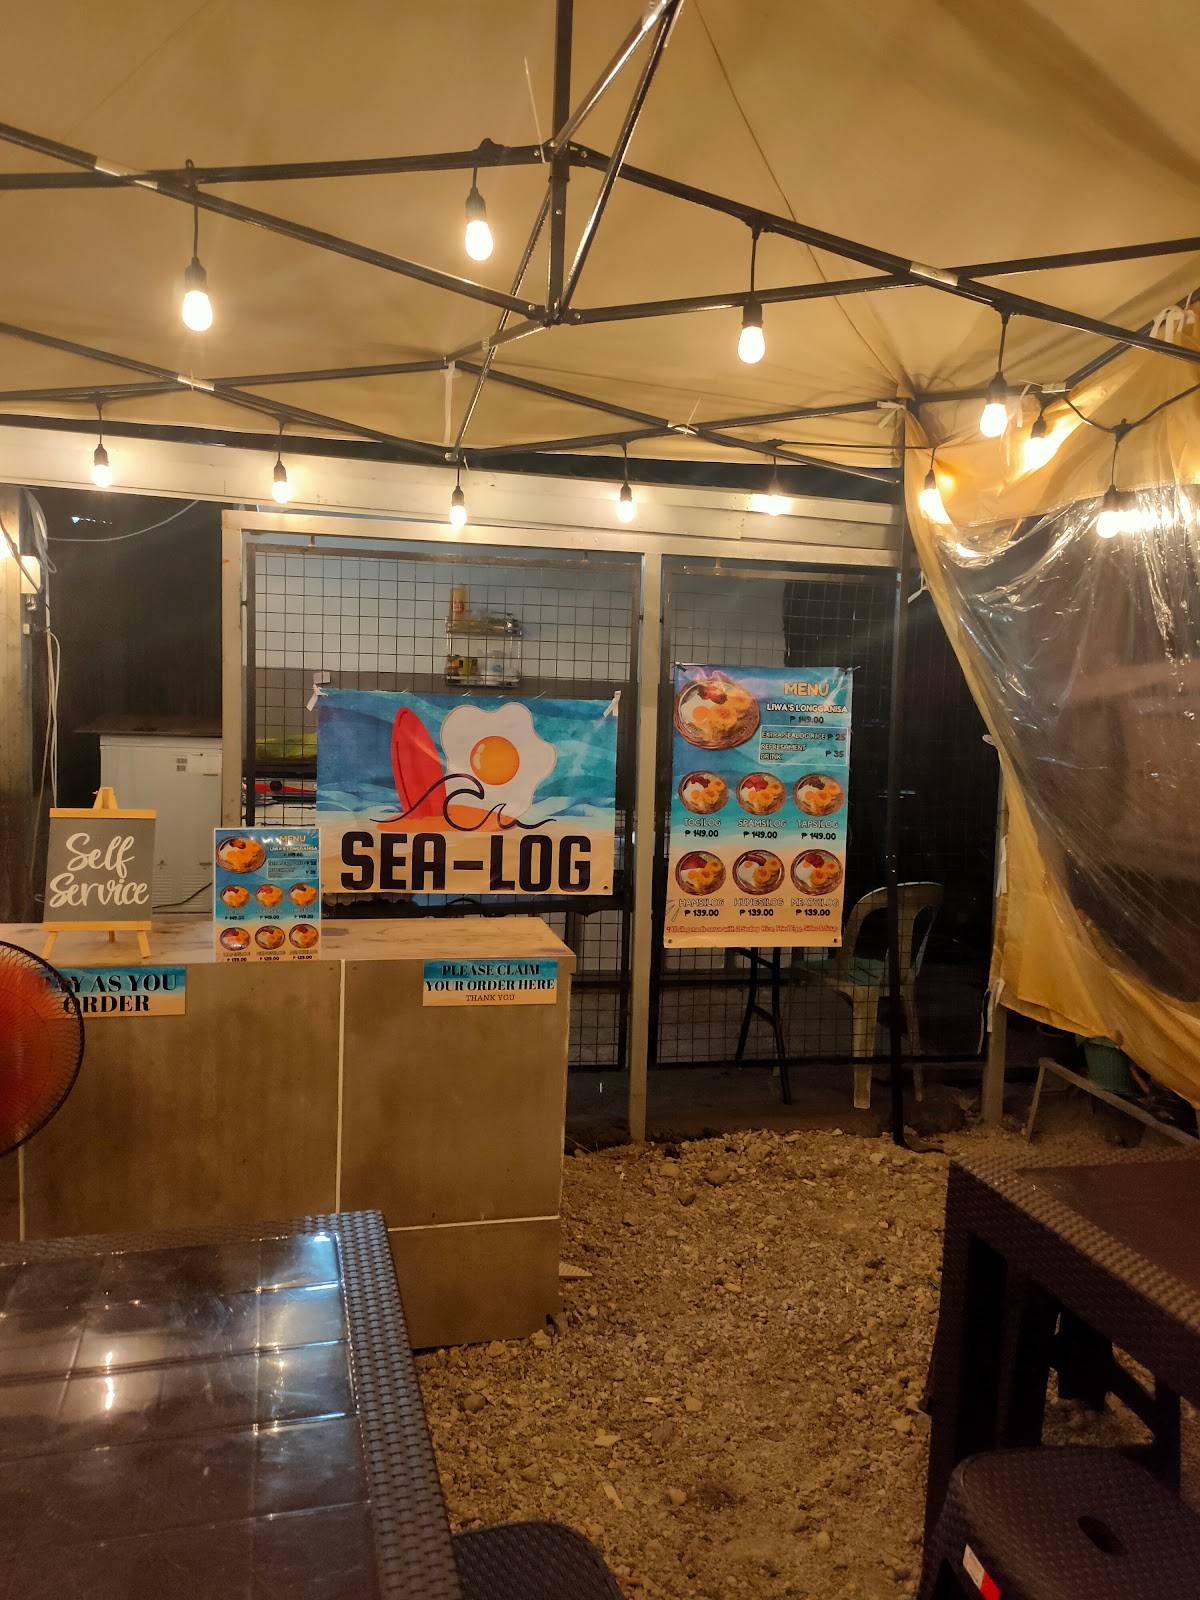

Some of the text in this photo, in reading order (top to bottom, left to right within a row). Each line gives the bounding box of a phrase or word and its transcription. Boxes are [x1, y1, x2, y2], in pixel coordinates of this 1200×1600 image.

[784, 682, 830, 698] MENU
[766, 703, 848, 714] LIWA'S LONGGANISA
[798, 716, 825, 724] 149.00
[761, 743, 806, 751] REFRESHMENT
[738, 819, 786, 828] SPAMSILOG
[693, 829, 719, 838] 149.00
[751, 830, 778, 839] 149.00
[809, 832, 837, 840] 149.00
[66, 832, 135, 879] Self
[340, 831, 591, 892] SEA-LOG
[49, 872, 149, 908] Service
[678, 898, 725, 908] HAMSILOG
[692, 909, 720, 917] 139.00
[747, 909, 774, 917] 139.00
[804, 909, 831, 917] 139.00
[442, 964, 540, 976] PLEASE CLAIM
[91, 975, 122, 993] AS
[127, 973, 177, 991] YOU
[426, 979, 555, 991] YOUR ORDER HERE
